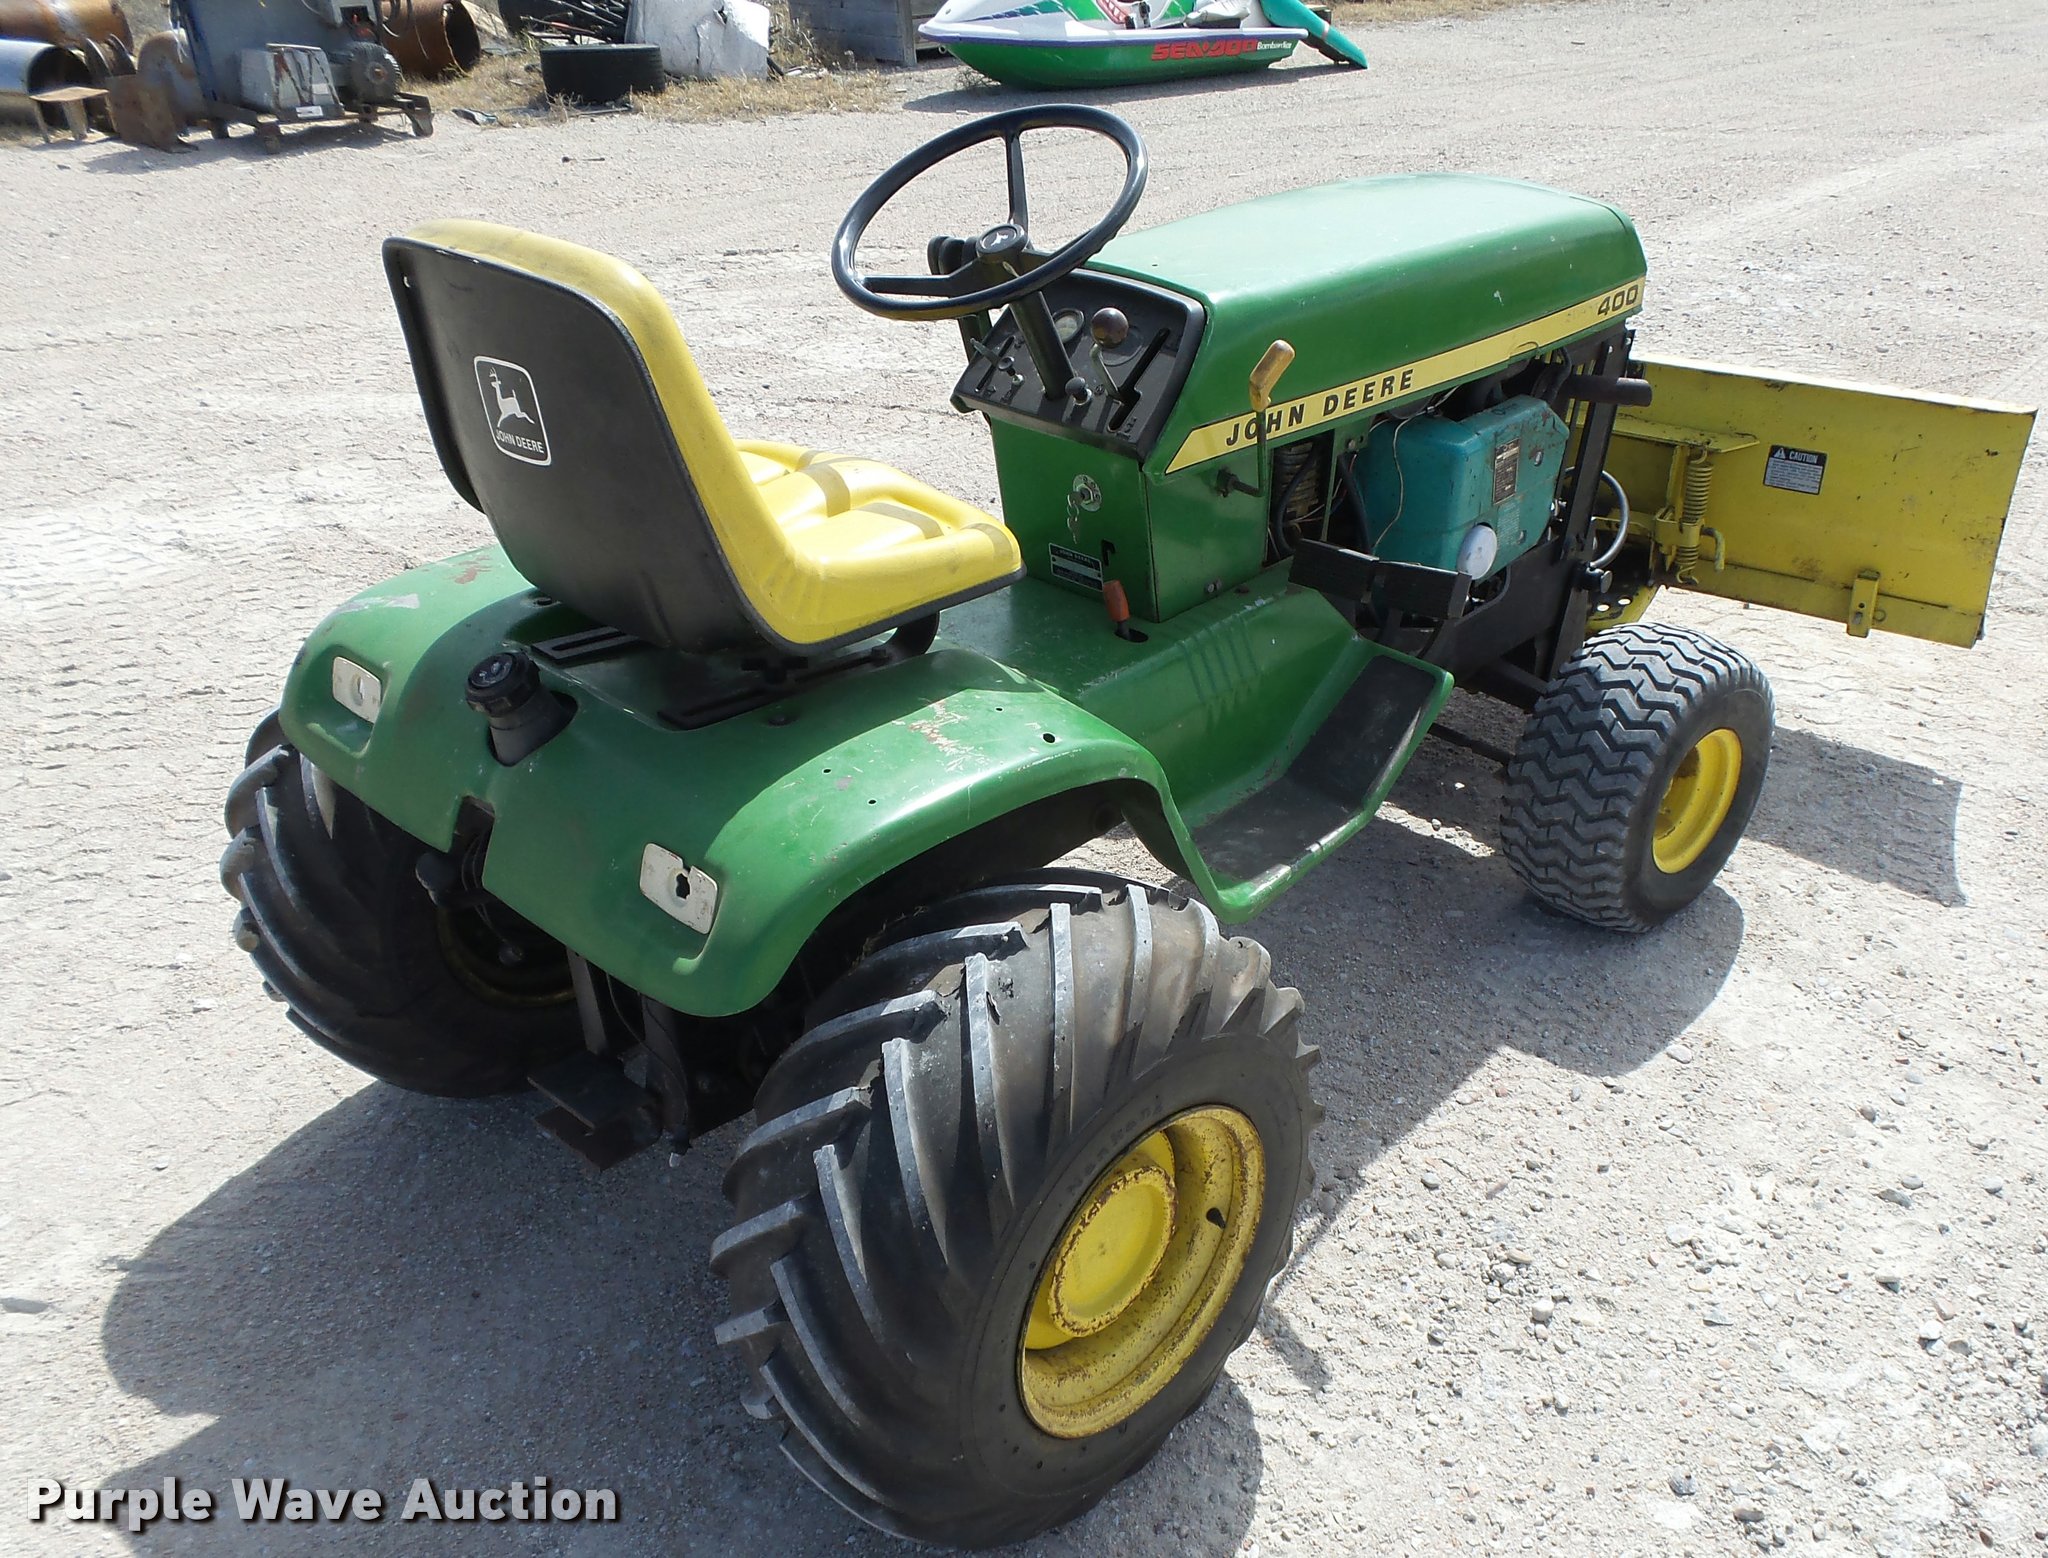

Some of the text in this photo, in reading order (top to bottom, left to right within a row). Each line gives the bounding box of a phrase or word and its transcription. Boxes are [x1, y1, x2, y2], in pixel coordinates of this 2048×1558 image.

[1597, 284, 1639, 316] 400
[1226, 369, 1414, 446] JOHN DEERE
[496, 429, 544, 454] JOHN DEERE
[1789, 451, 1818, 464] CAUTION
